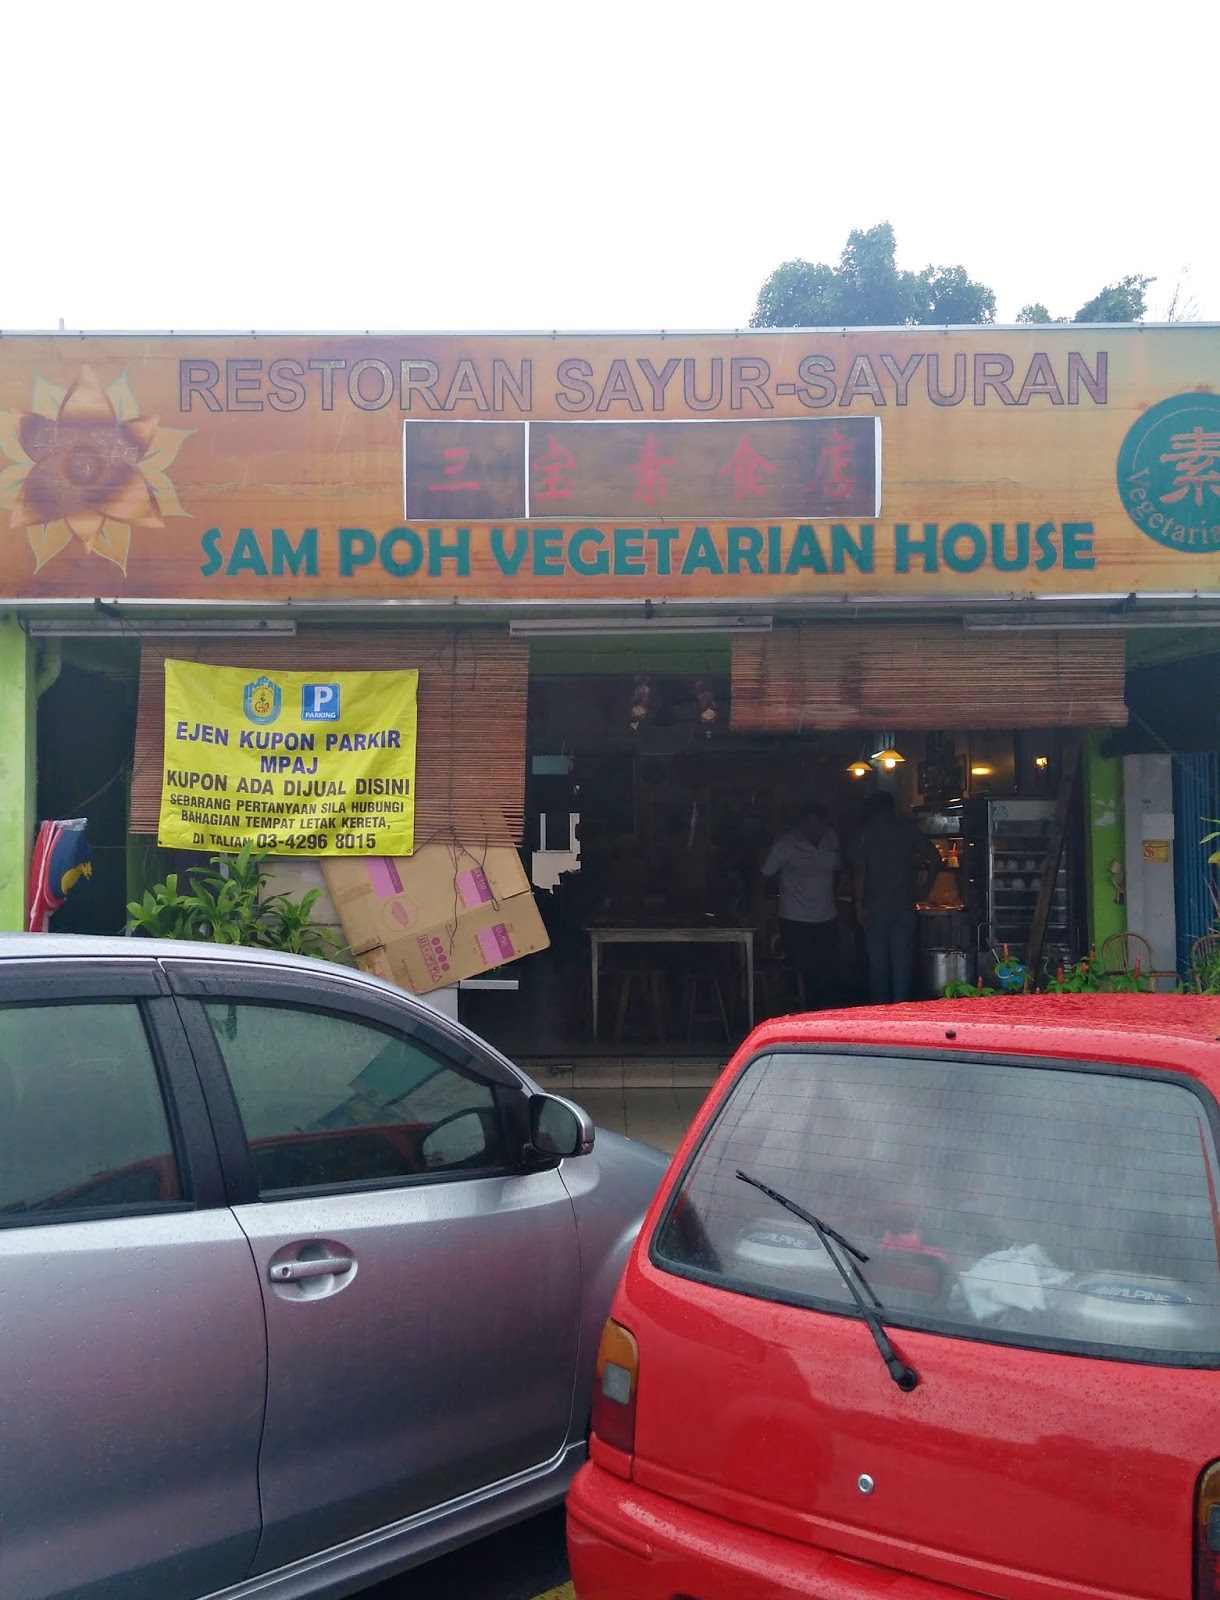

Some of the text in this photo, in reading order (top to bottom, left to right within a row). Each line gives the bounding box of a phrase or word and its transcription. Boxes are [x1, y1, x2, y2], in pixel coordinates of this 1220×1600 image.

[179, 351, 1108, 413] RESTORAN SAYUR-SAYURAN
[1159, 426, 1220, 506] 素
[201, 520, 1096, 578] SAM POH VEGETARIAN HOUSE
[176, 721, 401, 751] EJEN KUPON PARKIR
[260, 755, 318, 775] MPAJ
[166, 770, 410, 797] KUPON ADA DIJUAL DISINI
[169, 793, 404, 815] SEBARANG PERTANYAAN SILA HUBUNGI
[181, 810, 240, 827] BAHAGIAN
[245, 816, 296, 829] TEMPAT
[299, 817, 336, 829] LETAK
[192, 832, 205, 844] DI
[256, 833, 328, 849] 03-4296
[335, 833, 376, 849] 8015
